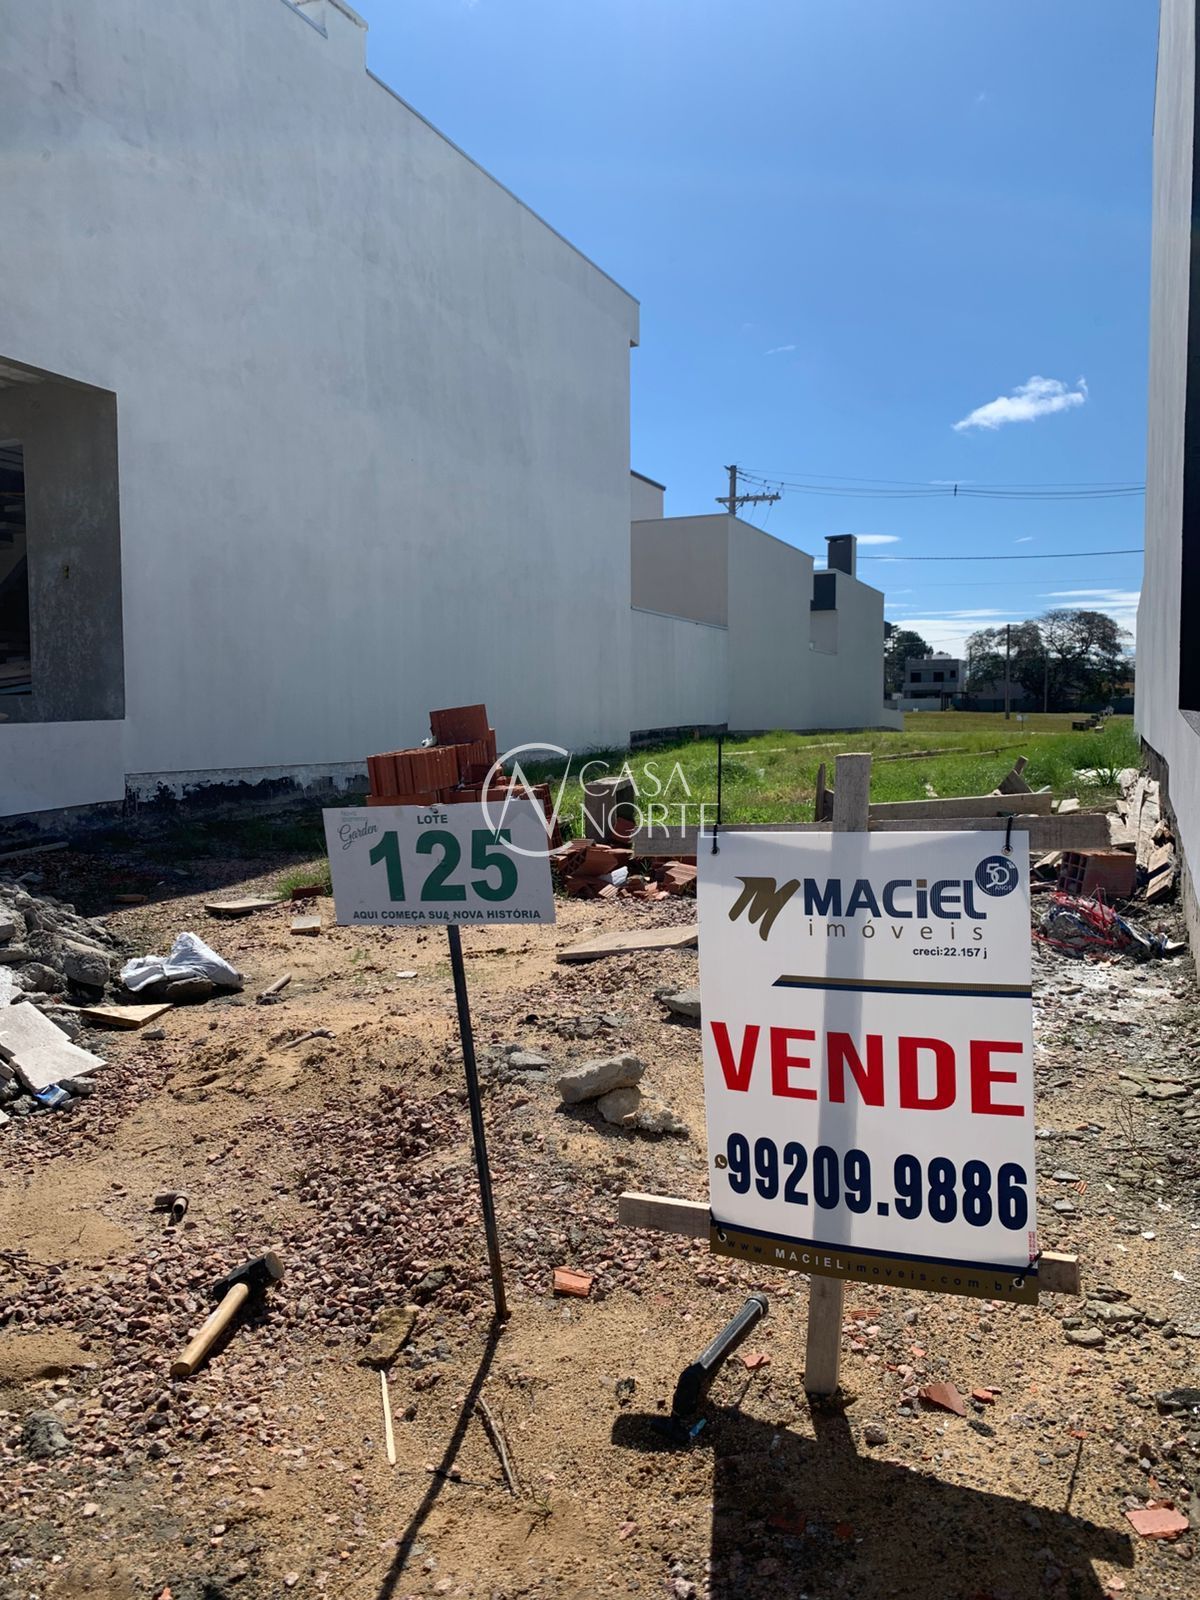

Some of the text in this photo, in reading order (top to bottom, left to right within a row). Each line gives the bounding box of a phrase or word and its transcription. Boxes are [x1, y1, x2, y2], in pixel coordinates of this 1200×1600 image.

[416, 814, 449, 825] LOTE
[336, 822, 378, 851] Garden
[369, 829, 519, 902] 125
[353, 908, 541, 921] AQUI COMEÇA SUA NOVA HISTÓRIA
[808, 918, 983, 941] imóveis
[710, 1021, 1026, 1117] VENDE
[726, 1132, 1029, 1231] 99209.9886
